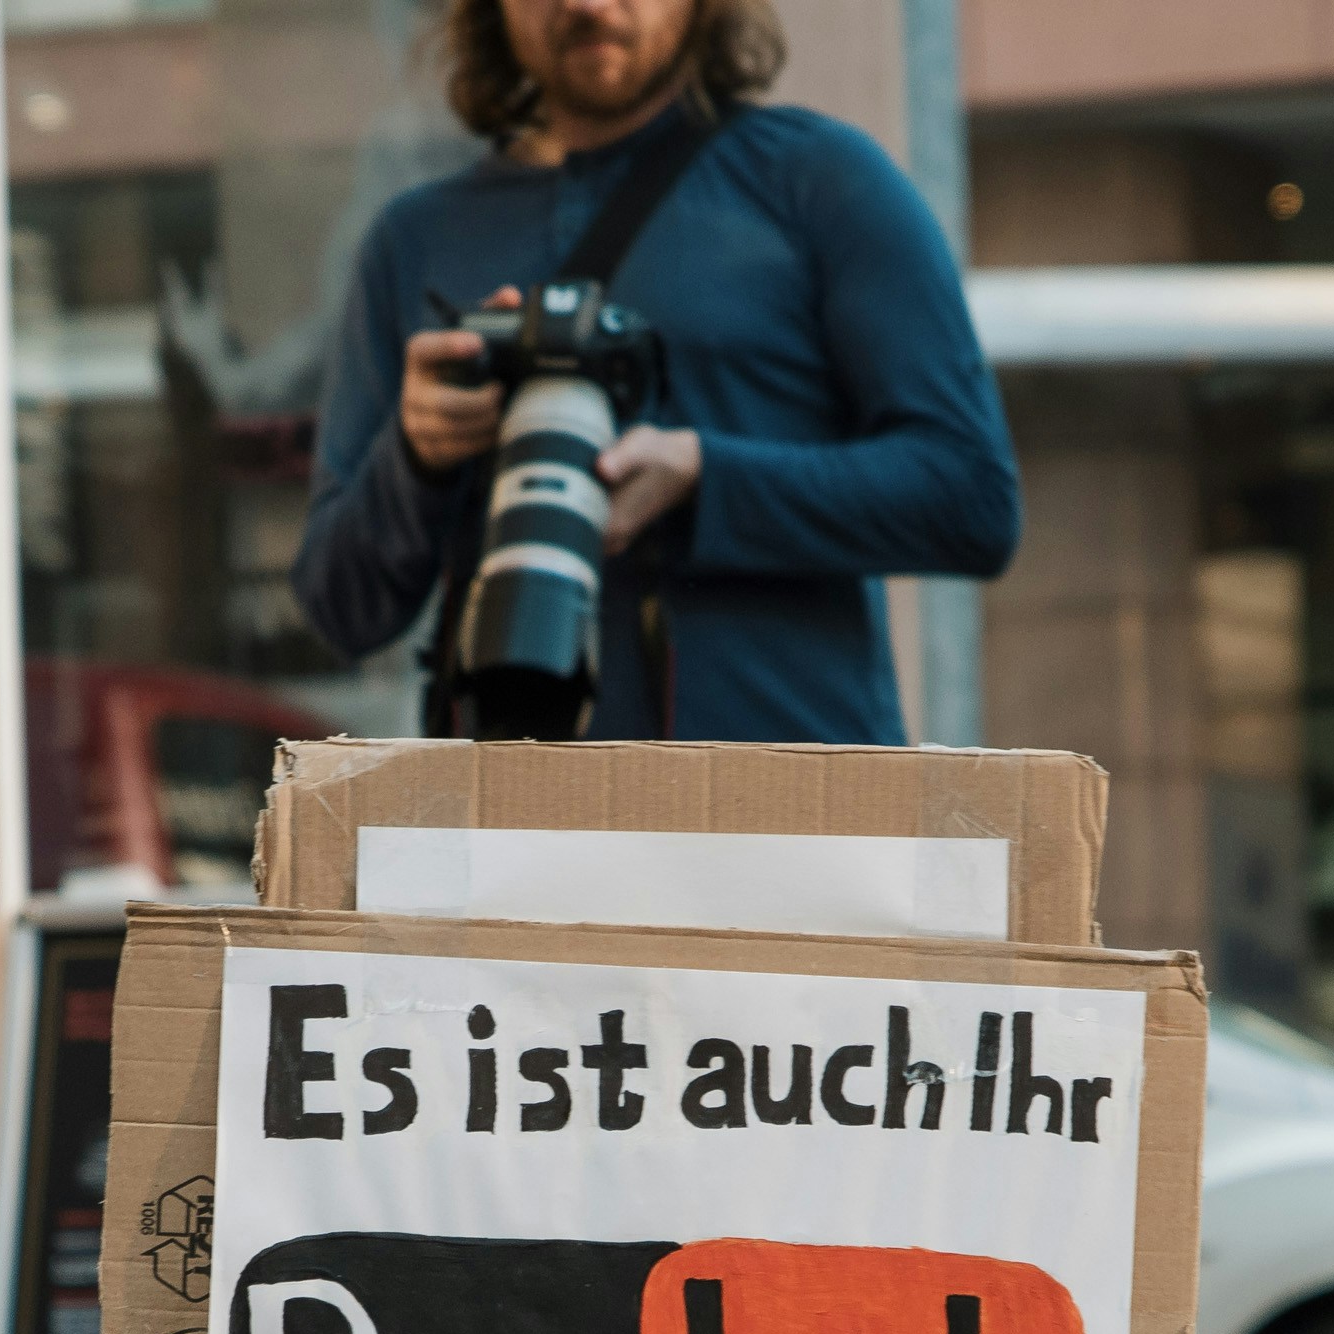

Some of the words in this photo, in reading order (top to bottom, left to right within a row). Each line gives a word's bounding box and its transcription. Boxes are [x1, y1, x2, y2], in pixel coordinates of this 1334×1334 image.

[264, 984, 419, 1140] Es
[466, 1004, 648, 1133] ist
[681, 1005, 946, 1131] auch
[970, 1011, 1113, 1144] Ihr
